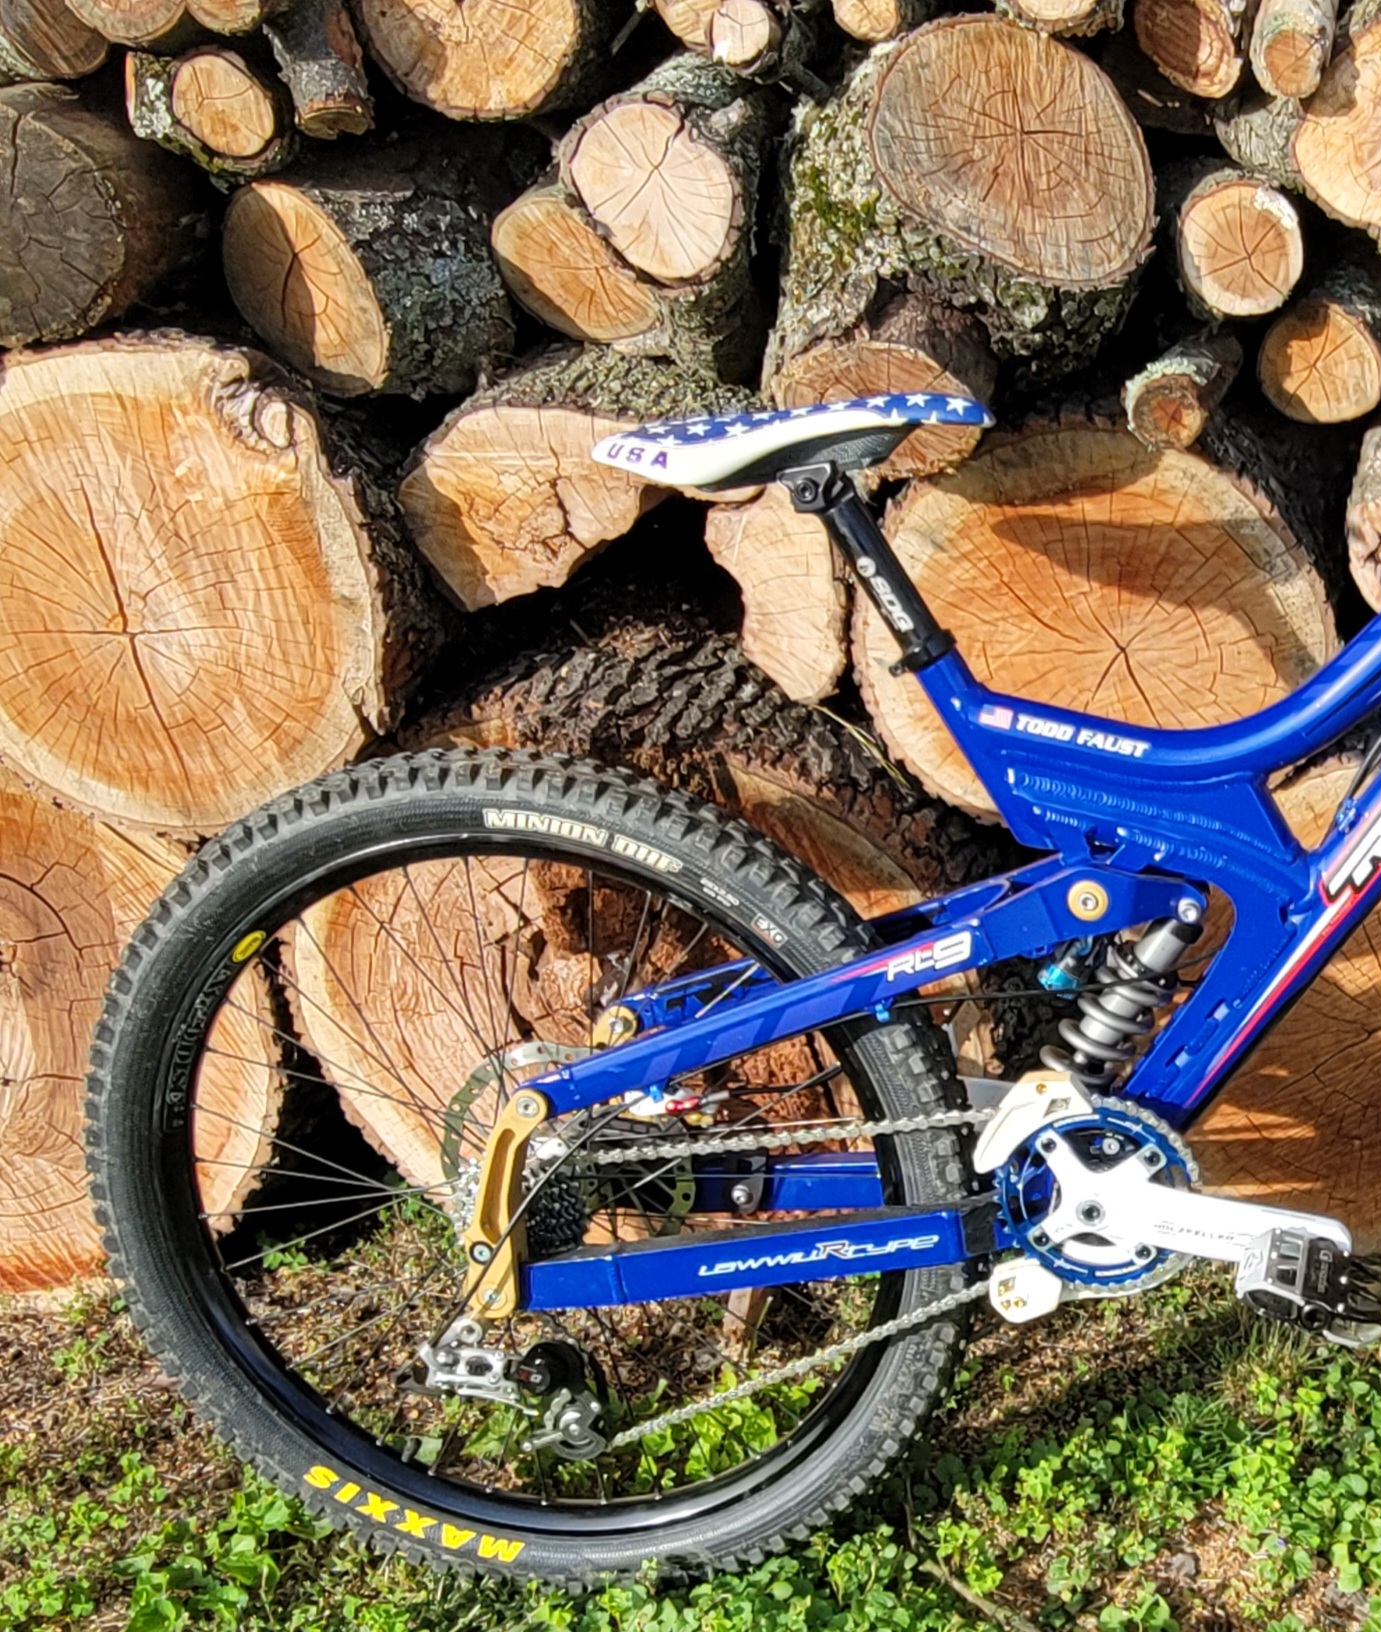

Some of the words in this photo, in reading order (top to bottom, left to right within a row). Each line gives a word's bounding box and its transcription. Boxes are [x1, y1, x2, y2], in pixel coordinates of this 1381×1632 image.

[606, 443, 669, 470] USA
[869, 575, 916, 632] SDG
[1015, 713, 1075, 741] TODD
[1076, 728, 1150, 758] FAUST
[483, 808, 608, 848] MINION
[755, 915, 786, 945] EXO
[303, 1464, 526, 1563] MAXXIS
